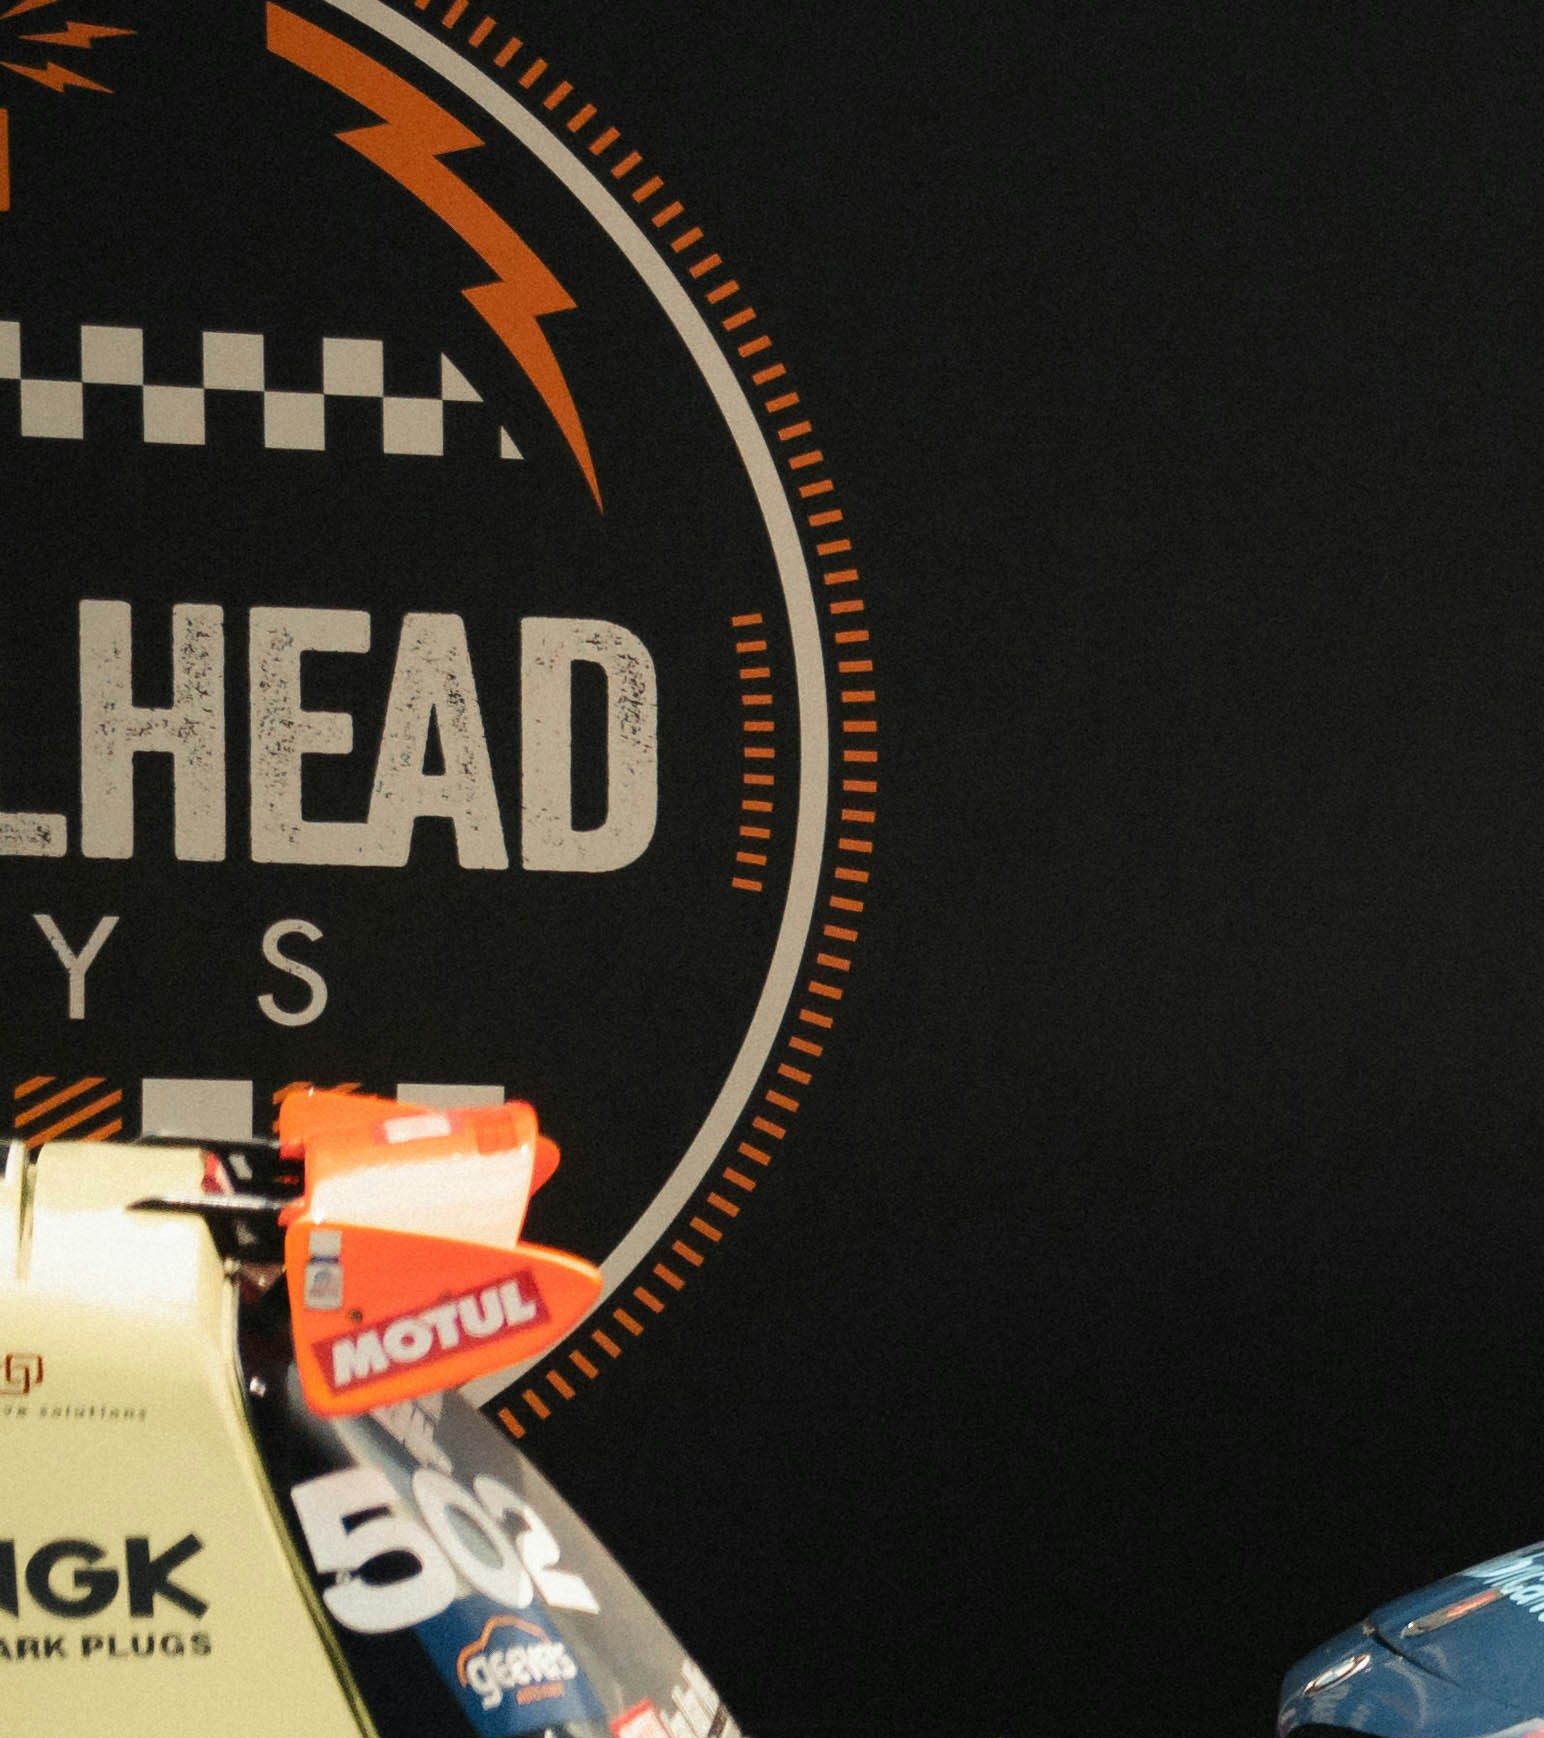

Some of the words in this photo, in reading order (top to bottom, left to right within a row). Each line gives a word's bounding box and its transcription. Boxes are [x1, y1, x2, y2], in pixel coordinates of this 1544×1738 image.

[0, 600, 658, 873] HEAD
[332, 1279, 538, 1388] MOTUL
[0, 1533, 210, 1620] GK
[290, 1465, 601, 1635] 502
[81, 1632, 213, 1658] PLUGS
